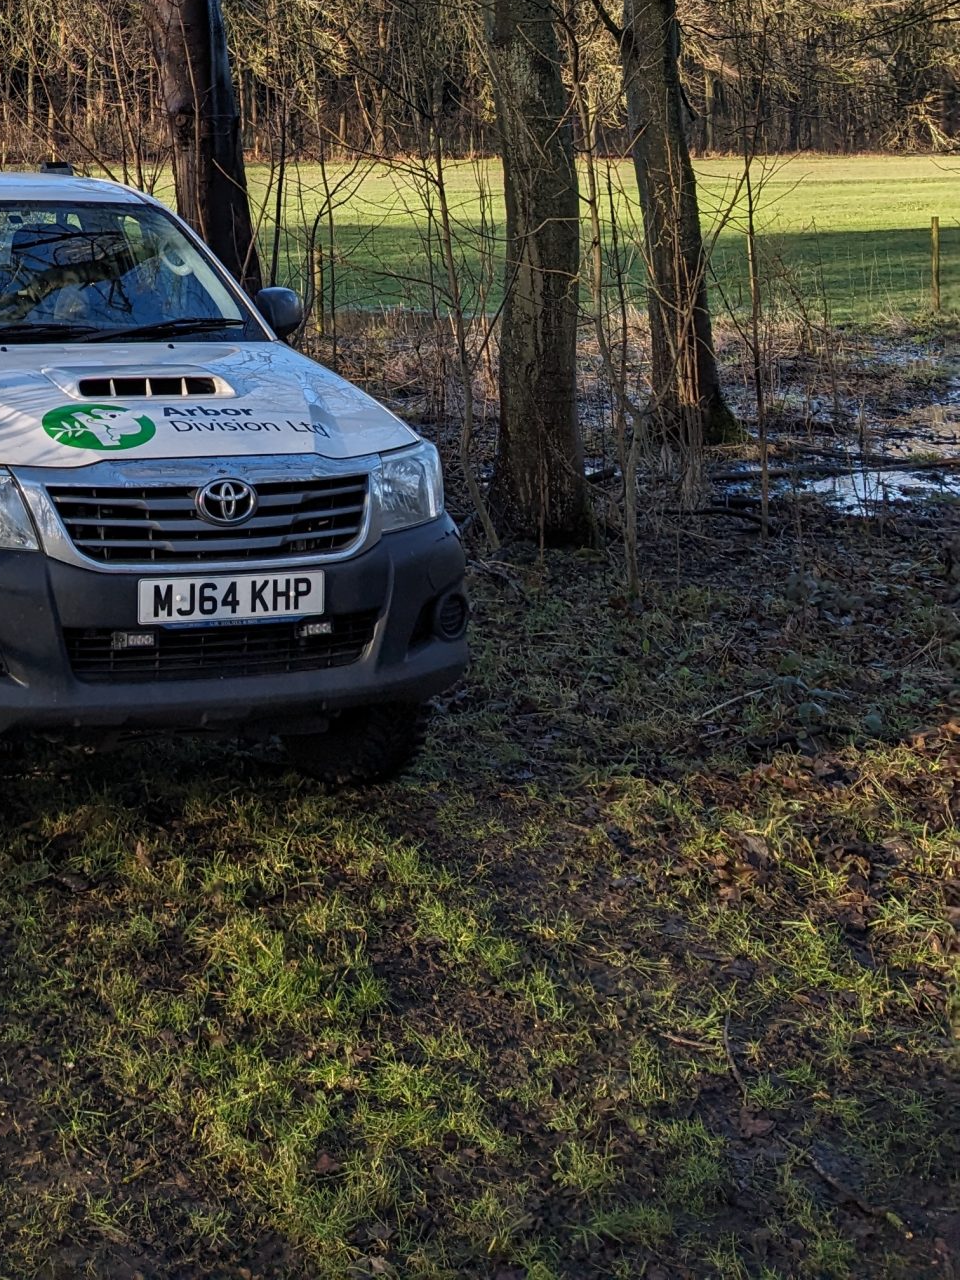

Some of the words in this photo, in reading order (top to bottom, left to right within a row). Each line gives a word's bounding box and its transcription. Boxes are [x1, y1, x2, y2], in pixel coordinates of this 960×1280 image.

[162, 406, 254, 418] Arbor
[168, 419, 282, 433] Division
[289, 420, 332, 439] Ltd
[153, 581, 240, 618] MJ64
[250, 577, 312, 613] KHP
